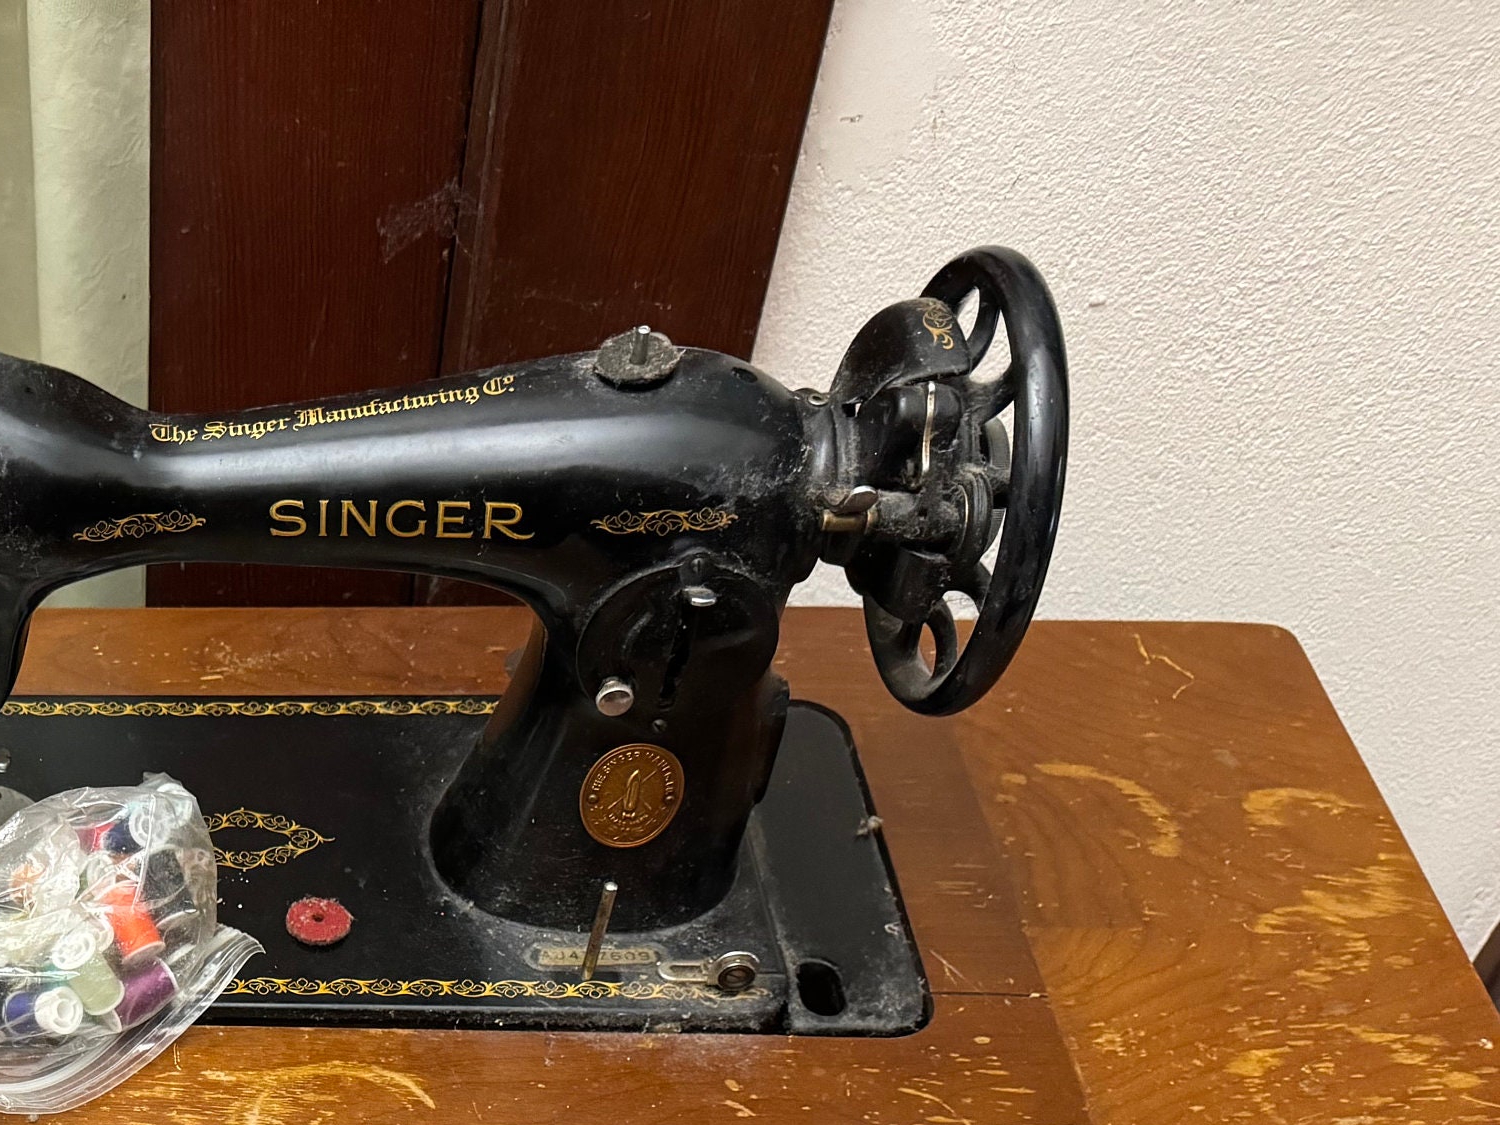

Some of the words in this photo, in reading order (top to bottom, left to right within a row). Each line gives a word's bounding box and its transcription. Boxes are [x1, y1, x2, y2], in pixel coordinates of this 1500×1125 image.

[149, 423, 198, 445] The
[201, 416, 291, 440] Singer
[292, 386, 480, 431] Manufacturing
[269, 499, 535, 540] SINGER
